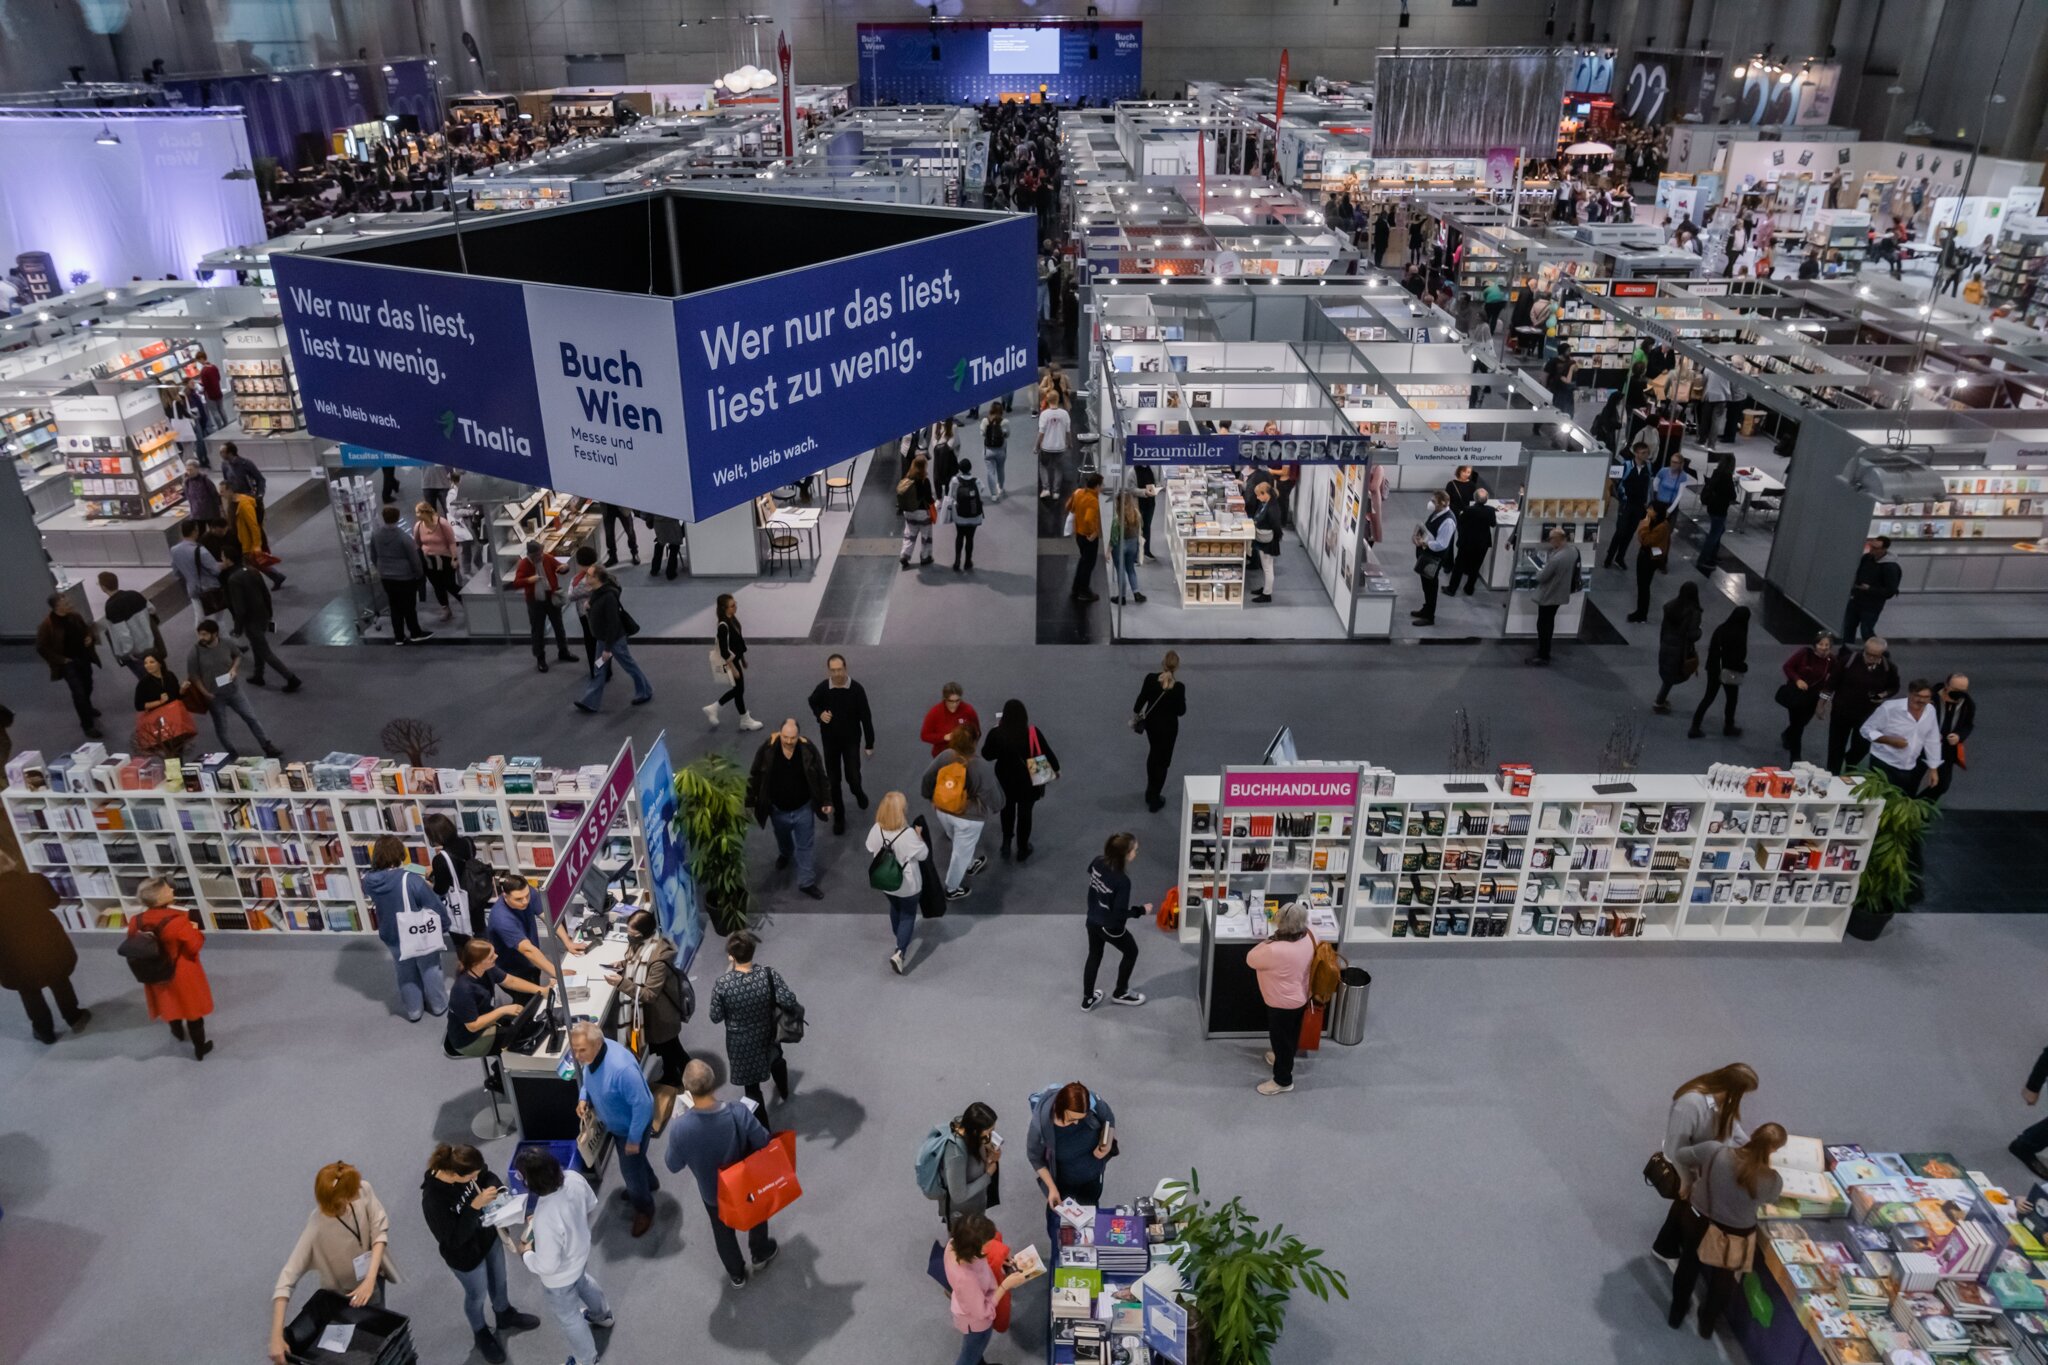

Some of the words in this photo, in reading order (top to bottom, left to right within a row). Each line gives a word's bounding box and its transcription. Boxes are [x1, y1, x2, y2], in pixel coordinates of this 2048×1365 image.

[1115, 32, 1136, 41] Buch
[1118, 41, 1139, 49] Wien
[290, 286, 331, 318] Wer
[339, 301, 371, 324] nur
[377, 299, 415, 331] das
[418, 304, 475, 345] liest,
[701, 320, 774, 371] Wer
[785, 307, 836, 348] nur
[844, 288, 892, 330] das
[900, 268, 960, 313] liest,
[300, 328, 342, 361] liest
[345, 344, 370, 366] zu
[374, 347, 447, 385] wenig.
[559, 341, 643, 388] Buch
[969, 345, 1028, 386] Thalia
[707, 374, 779, 431] liest
[787, 367, 822, 405] zu
[830, 331, 922, 388] wenig.
[314, 398, 341, 419] Welt,
[343, 404, 368, 423] bleib
[370, 412, 400, 430] wach.
[576, 386, 663, 434] Wien
[458, 417, 532, 457] Thalia
[571, 426, 607, 446] Messe
[611, 436, 634, 450] und
[1133, 440, 1223, 458] braumüller
[1433, 445, 1458, 453] Böhlau
[1460, 445, 1481, 454] Verlag
[573, 445, 618, 466] Festival
[712, 462, 748, 487] Welt,
[750, 449, 781, 474] bleib
[783, 436, 819, 462] wach.
[1415, 453, 1461, 461] Vandenhoeck
[1470, 453, 1503, 463] Ruprecht
[1230, 783, 1351, 797] BUCHHANDLUNG
[565, 782, 619, 888] KASSA
[408, 917, 437, 935] oag
